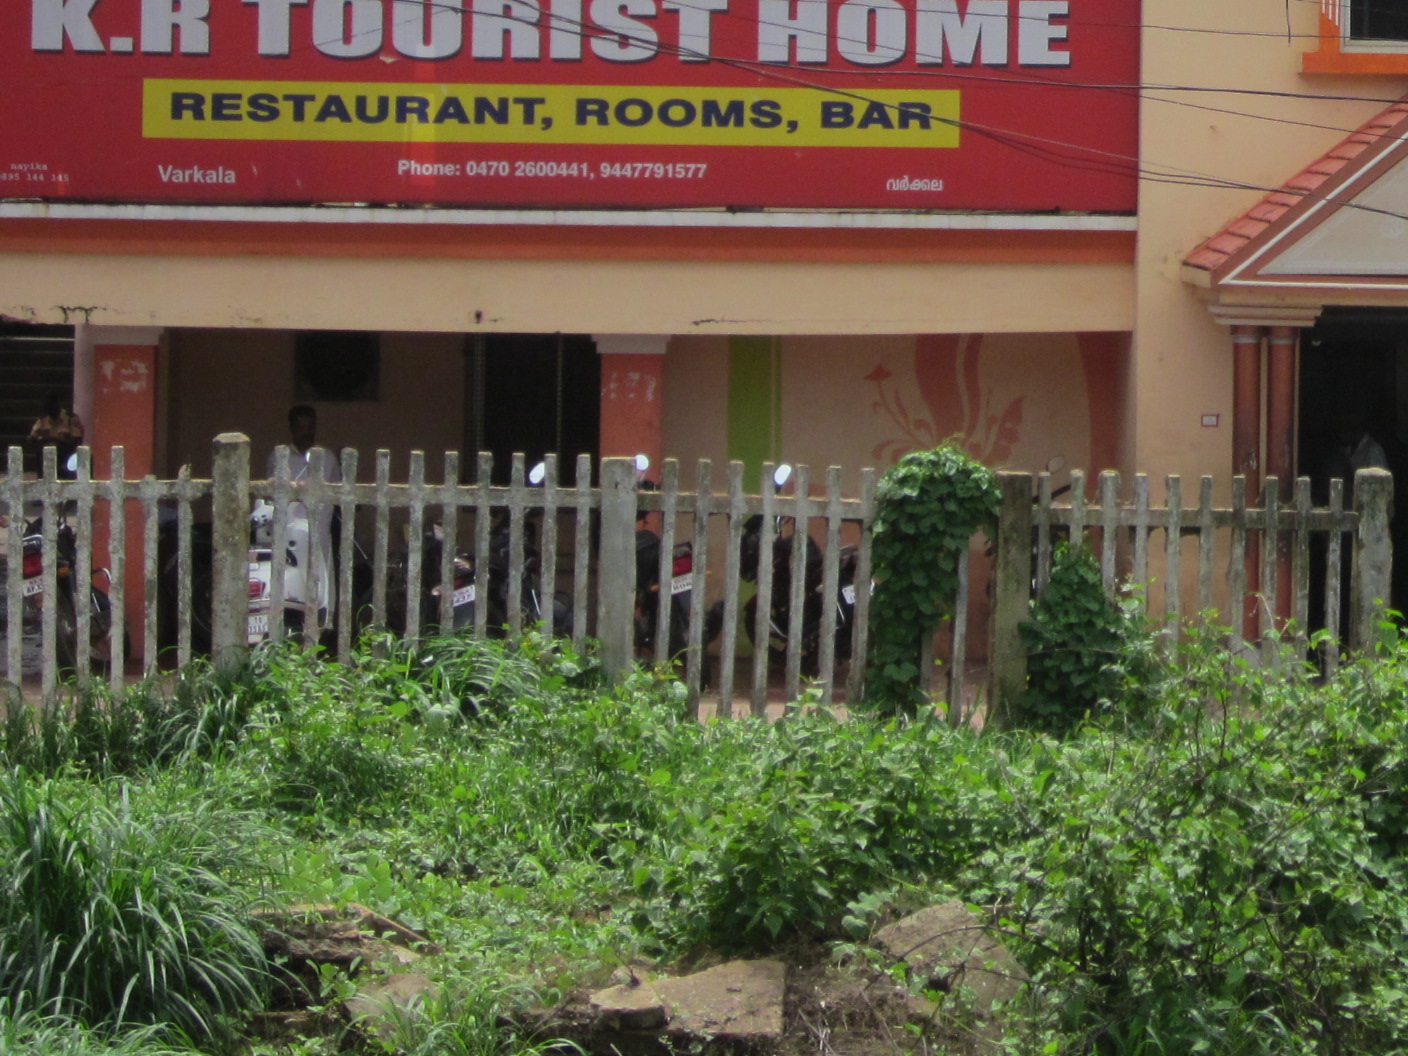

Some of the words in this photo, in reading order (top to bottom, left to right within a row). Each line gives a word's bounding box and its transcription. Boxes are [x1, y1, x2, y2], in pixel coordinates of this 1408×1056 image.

[170, 92, 555, 132] RESTAURANT,
[575, 97, 799, 134] ROOMS,
[820, 100, 933, 131] BAR
[157, 164, 237, 184] Varkala
[397, 159, 461, 176] Phone:
[465, 160, 510, 177] 0470
[514, 161, 596, 180] 2600441,
[599, 163, 708, 179] 9447791577
